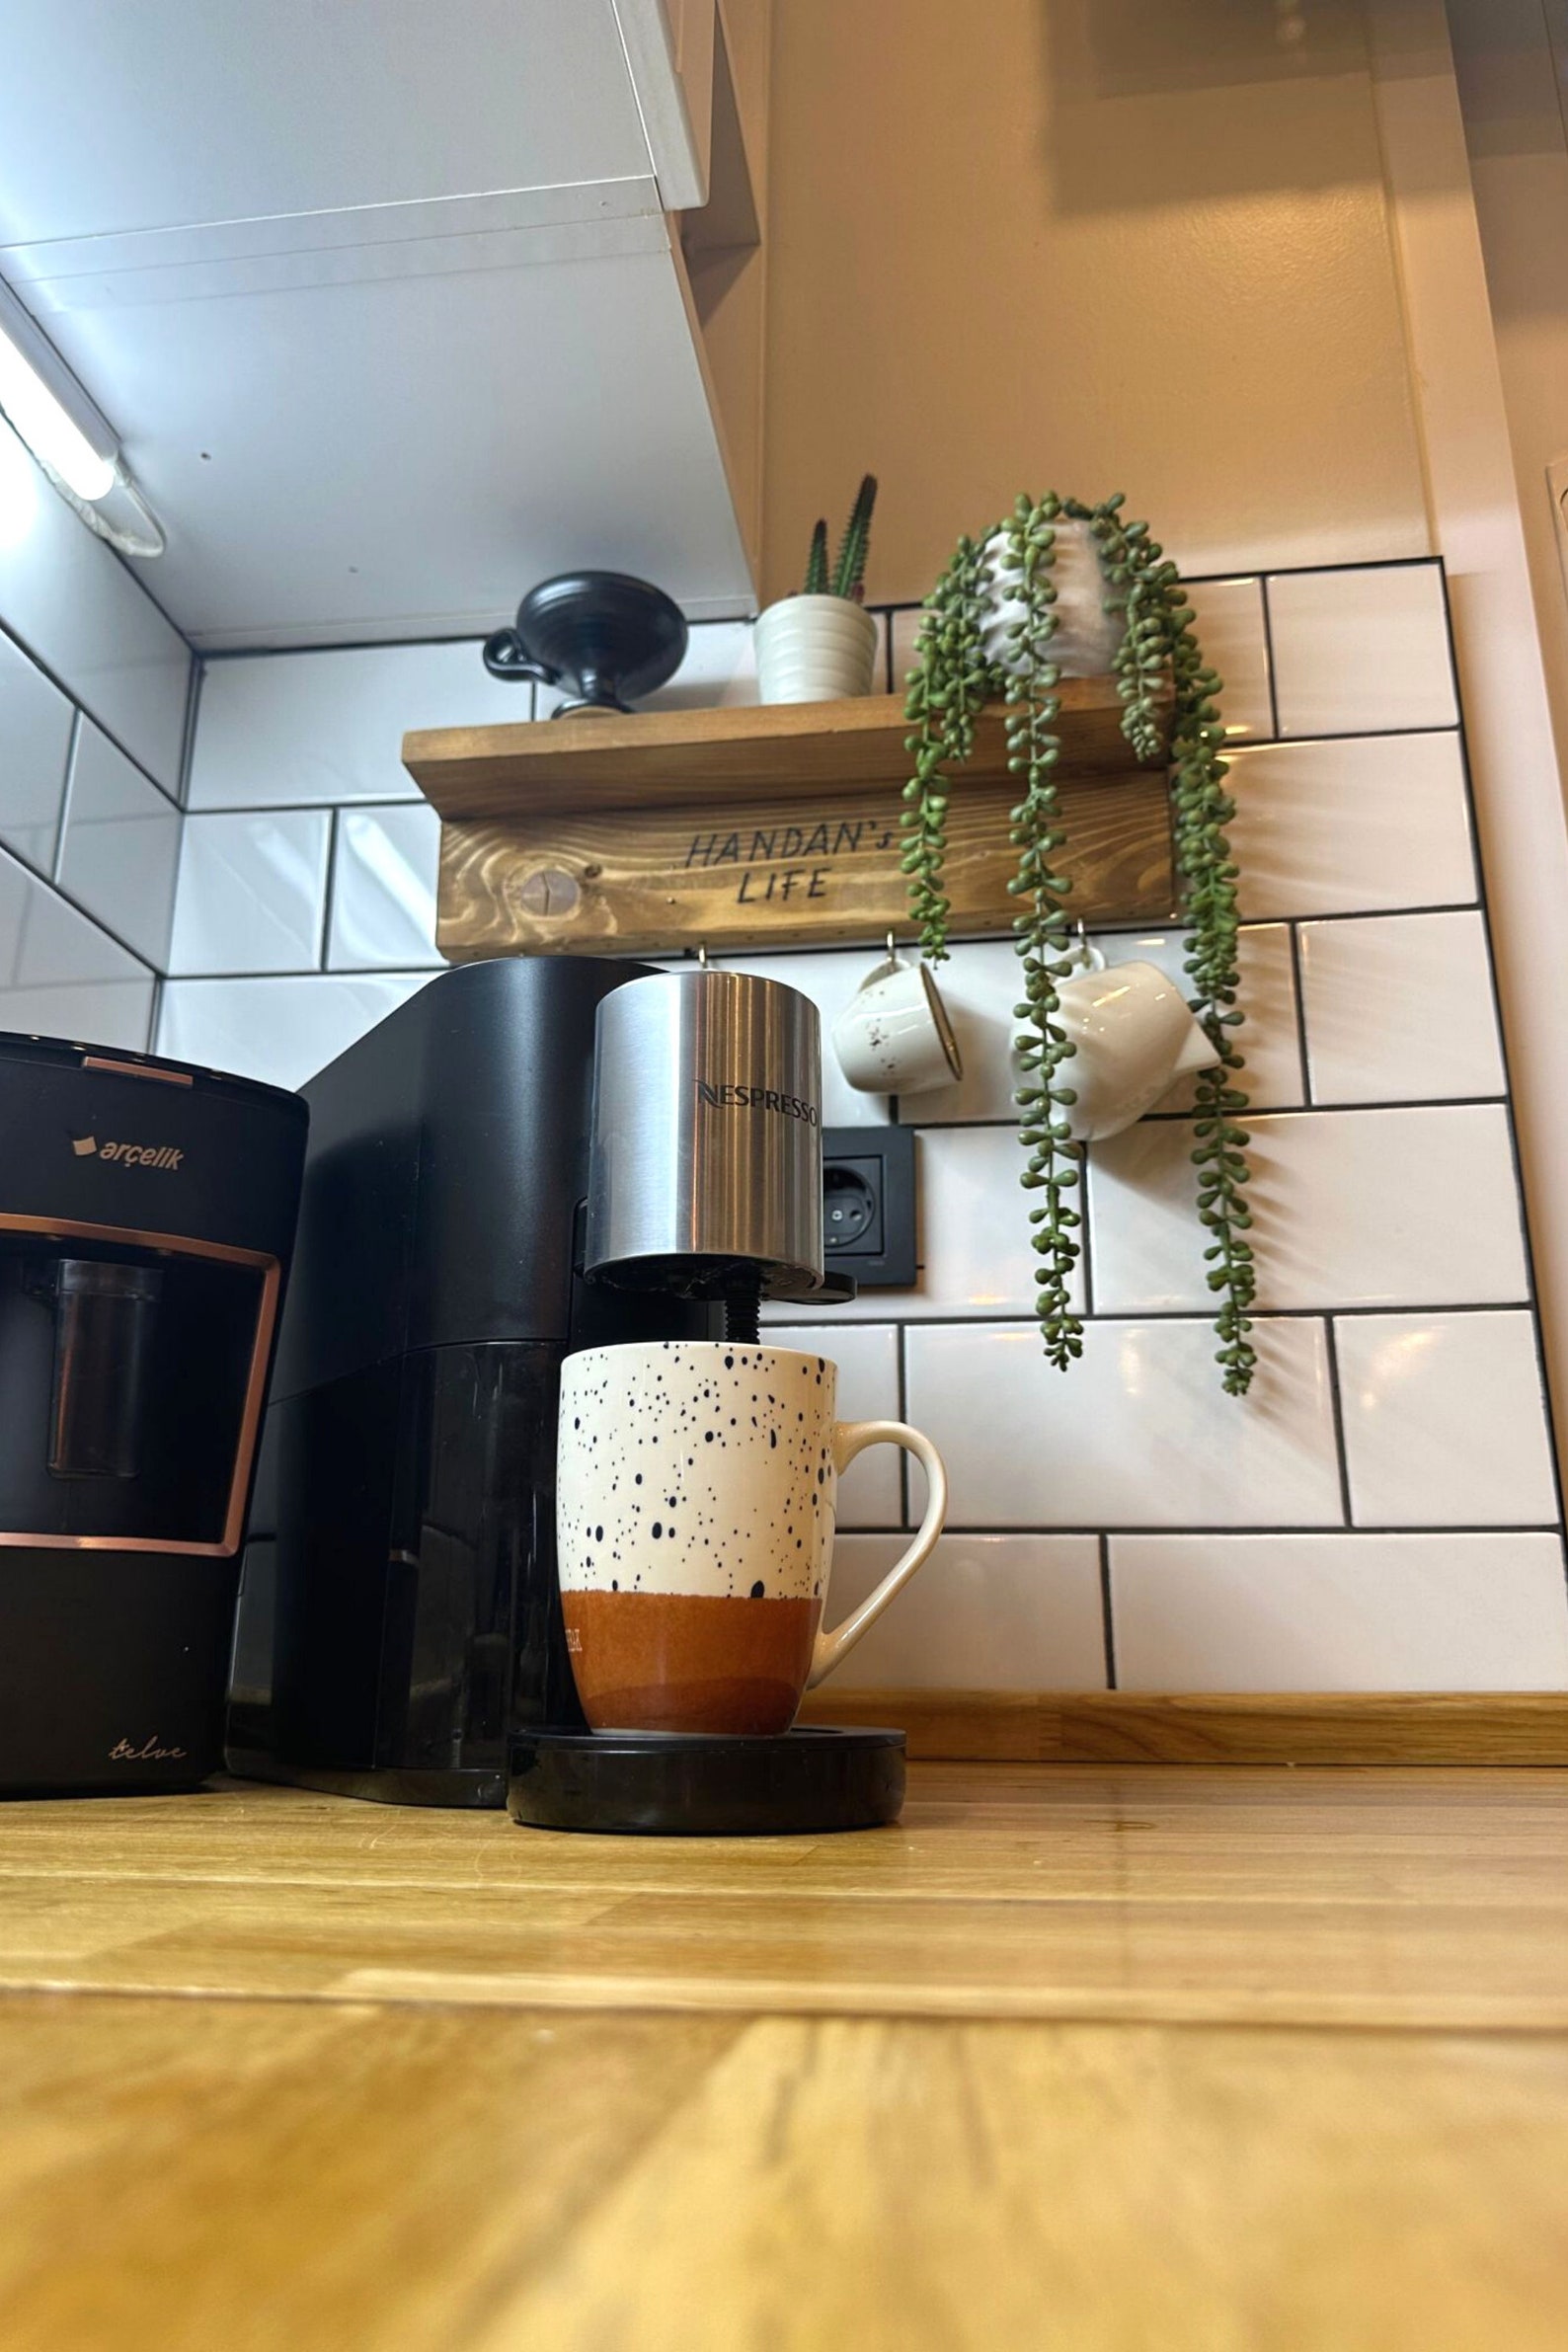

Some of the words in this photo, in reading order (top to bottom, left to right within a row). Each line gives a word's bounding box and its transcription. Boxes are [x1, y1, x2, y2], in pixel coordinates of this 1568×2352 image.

[685, 821, 894, 868] HANDAN's
[737, 868, 831, 903] LIFE
[691, 1078, 818, 1127] NESPRESSO
[100, 1141, 184, 1170] arçelik
